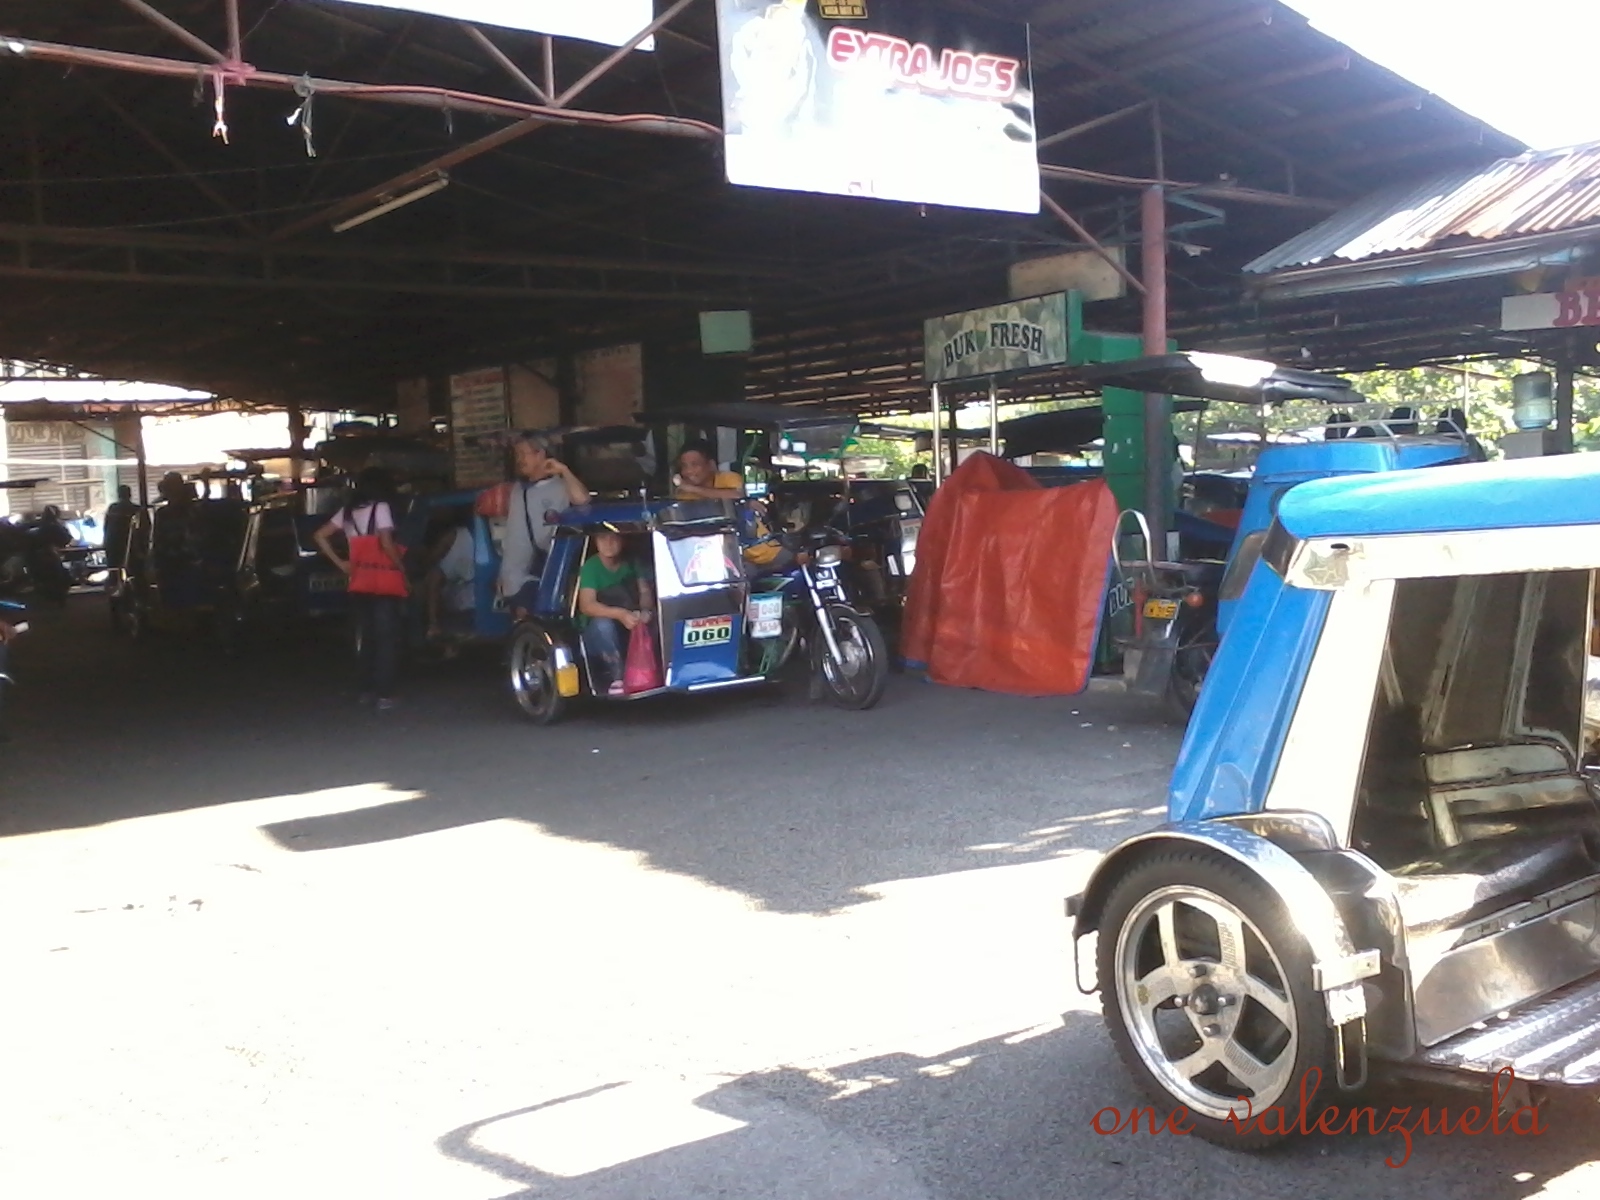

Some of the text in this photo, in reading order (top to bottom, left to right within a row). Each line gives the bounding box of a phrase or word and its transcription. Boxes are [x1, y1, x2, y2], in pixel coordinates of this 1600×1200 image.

[830, 29, 1018, 94] EXTRA JOSS
[989, 321, 1043, 354] FRESH
[687, 626, 730, 643] 060
